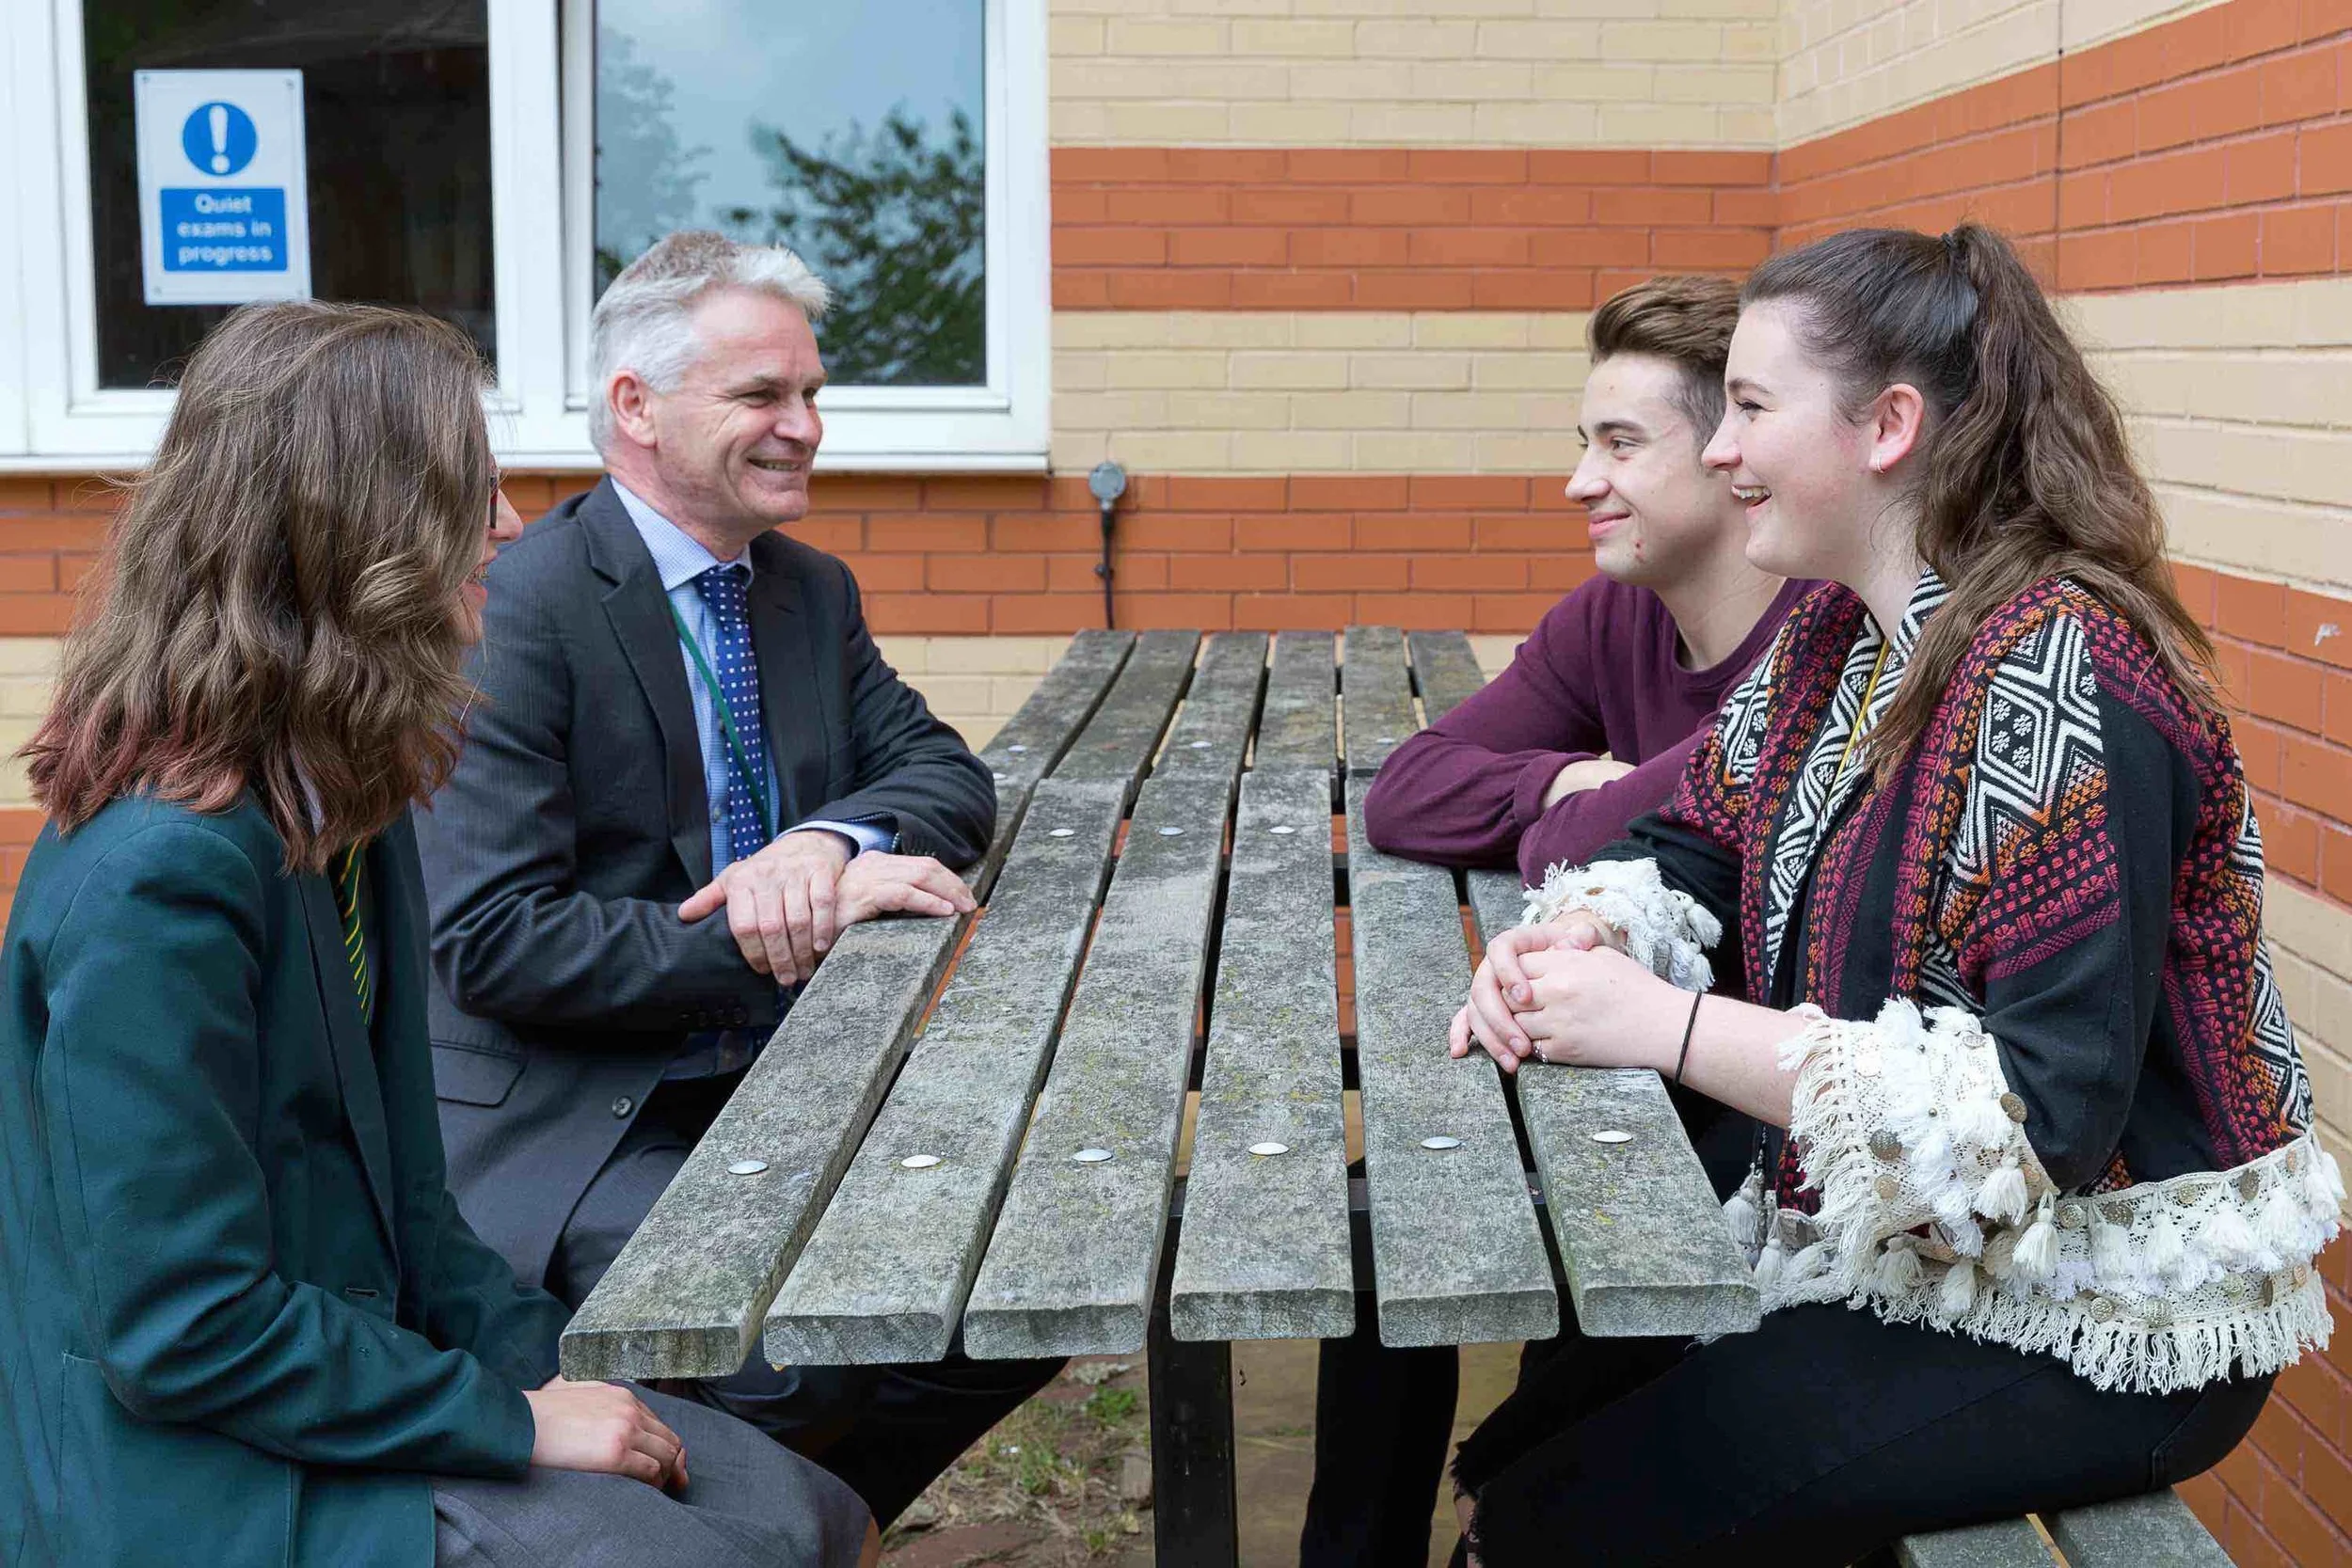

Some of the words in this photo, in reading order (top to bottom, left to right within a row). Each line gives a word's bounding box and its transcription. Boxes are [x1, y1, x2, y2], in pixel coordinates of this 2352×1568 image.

[195, 194, 252, 214] Quiet
[177, 221, 246, 238] exams
[251, 219, 272, 236] in
[179, 245, 273, 266] progress
